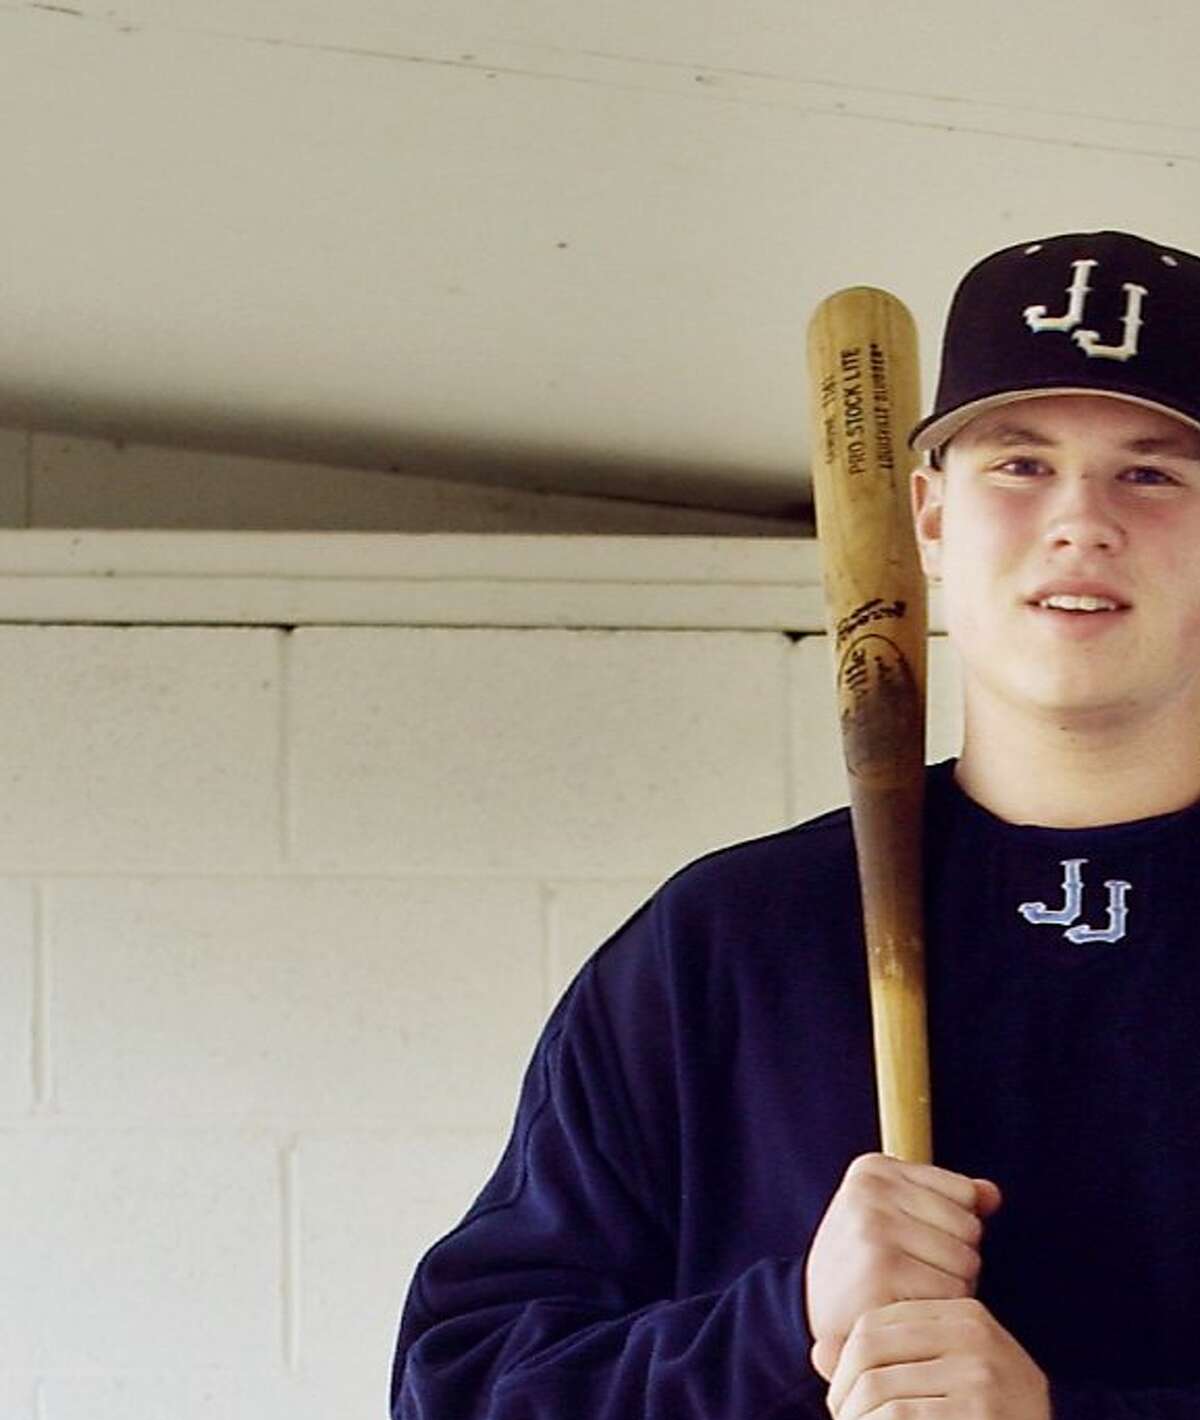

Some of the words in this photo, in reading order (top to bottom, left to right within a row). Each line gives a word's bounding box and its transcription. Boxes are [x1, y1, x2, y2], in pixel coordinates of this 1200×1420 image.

[840, 347, 862, 382] LITE
[842, 383, 865, 438] STOCK
[847, 441, 866, 475] PRO
